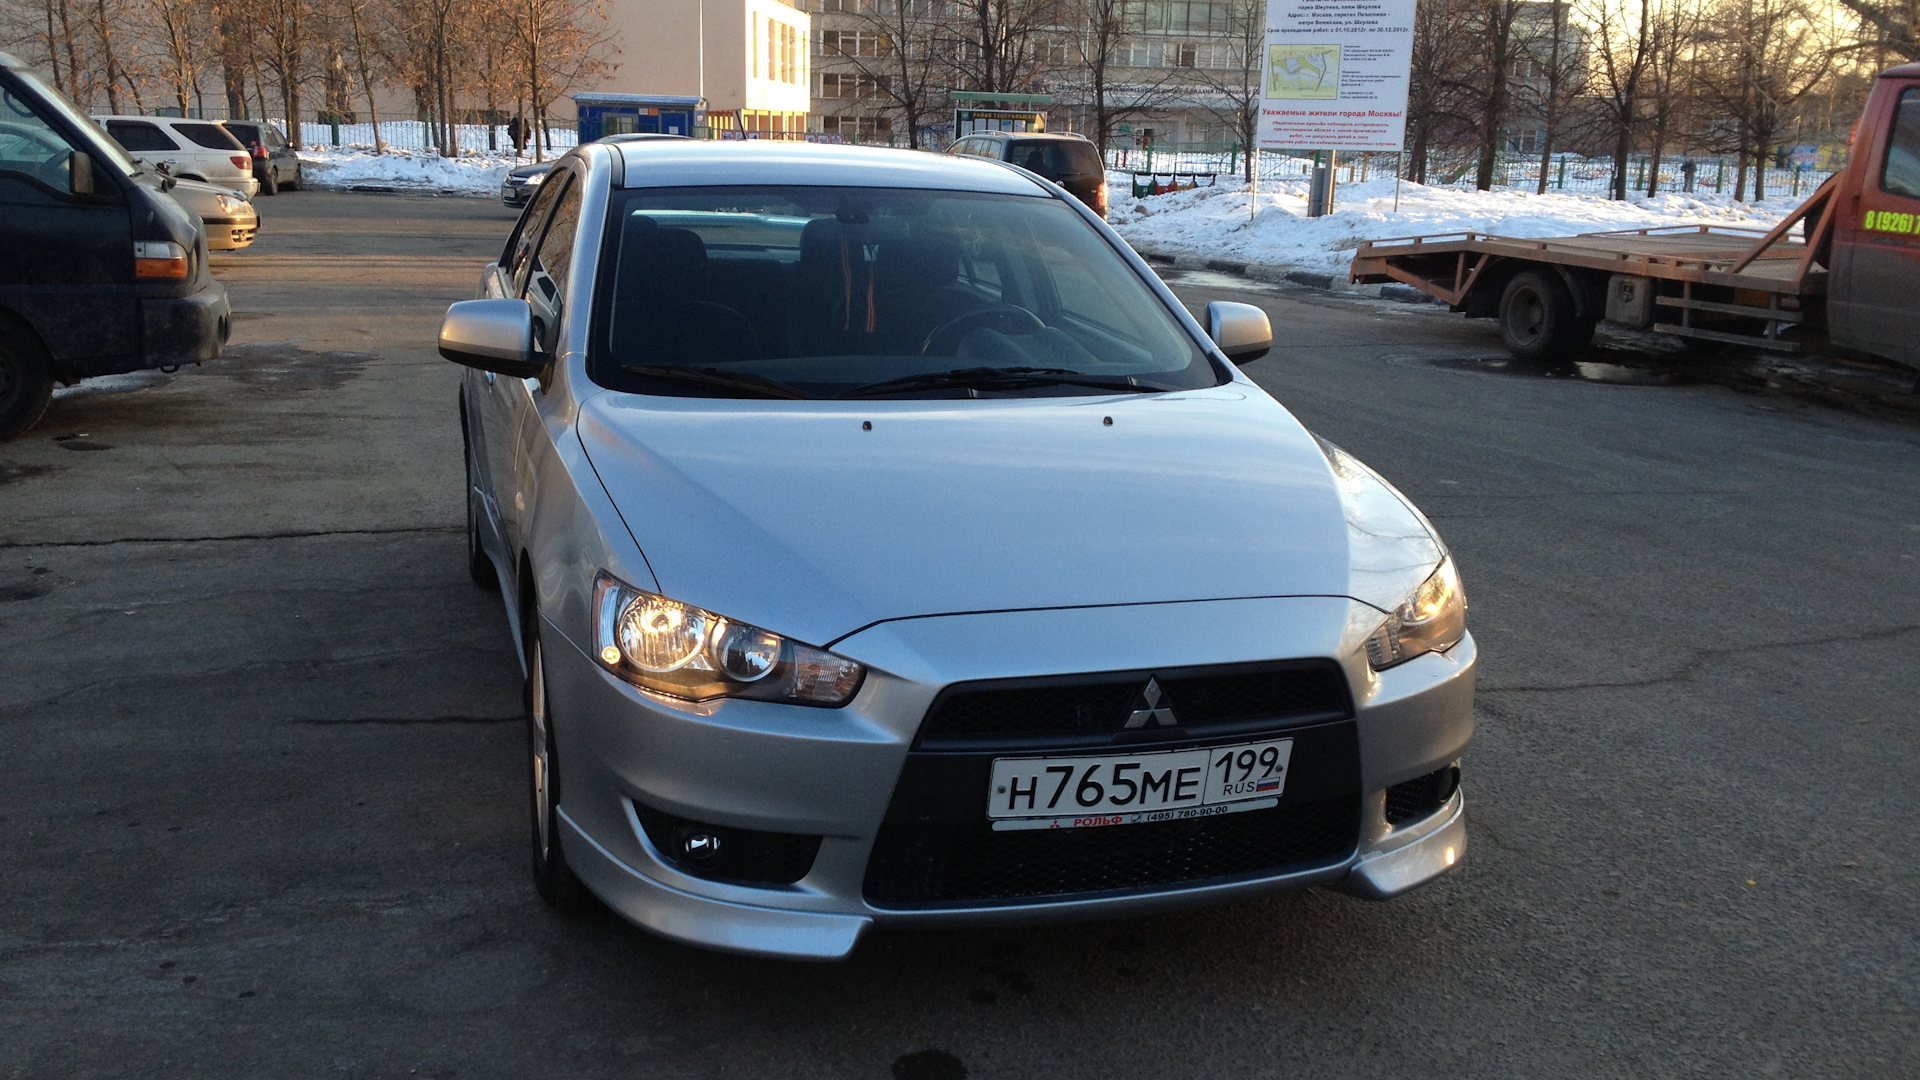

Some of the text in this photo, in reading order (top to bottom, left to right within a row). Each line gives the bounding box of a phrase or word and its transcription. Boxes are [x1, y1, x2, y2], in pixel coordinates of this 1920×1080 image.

[1262, 108, 1306, 116] Уважаемые
[1340, 110, 1366, 118] города
[1865, 210, 1875, 229] 8
[1876, 211, 1914, 233] (926)
[1215, 746, 1279, 783] 199
[1223, 781, 1255, 796] RUS
[1073, 805, 1228, 828] РОЛЬФ (495) 780-90-00
